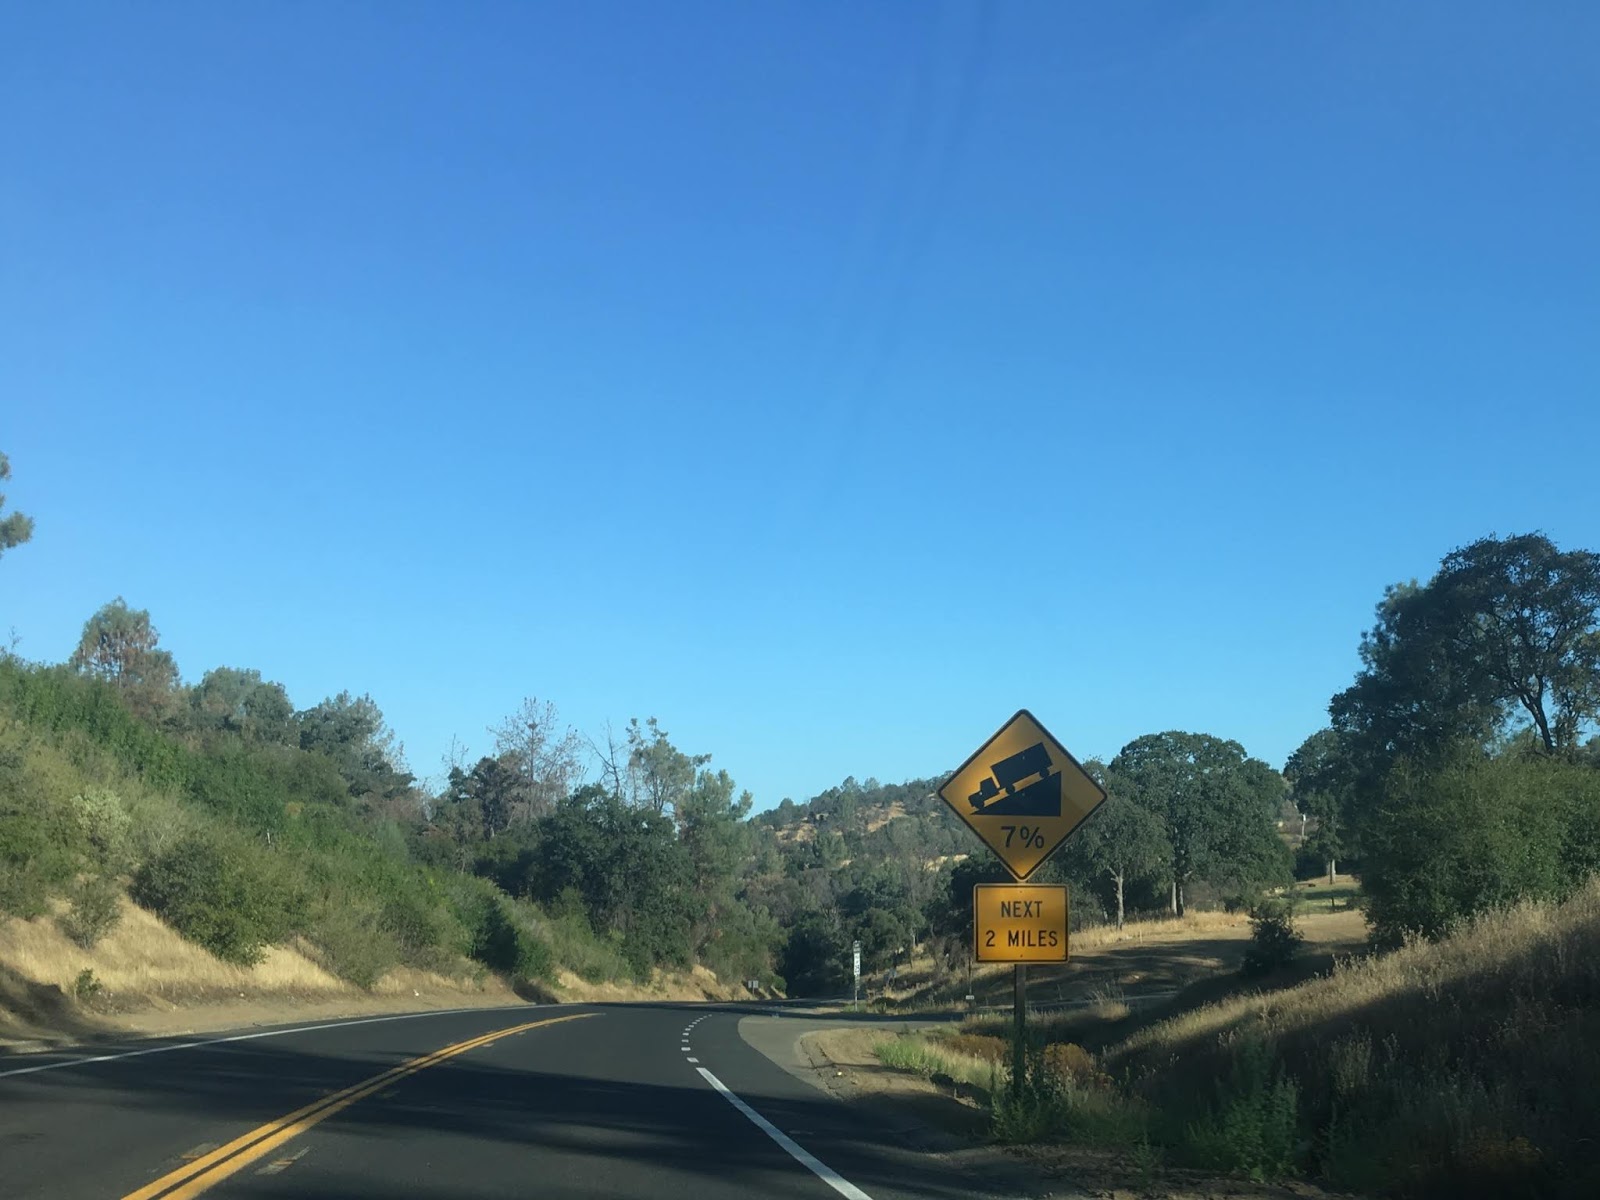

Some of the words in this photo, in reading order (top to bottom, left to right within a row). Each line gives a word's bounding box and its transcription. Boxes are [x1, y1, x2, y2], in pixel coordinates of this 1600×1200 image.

[1001, 826, 1045, 849] 7%
[1001, 901, 1043, 918] NEXT
[985, 930, 996, 947] 2
[1008, 930, 1058, 947] MILES
